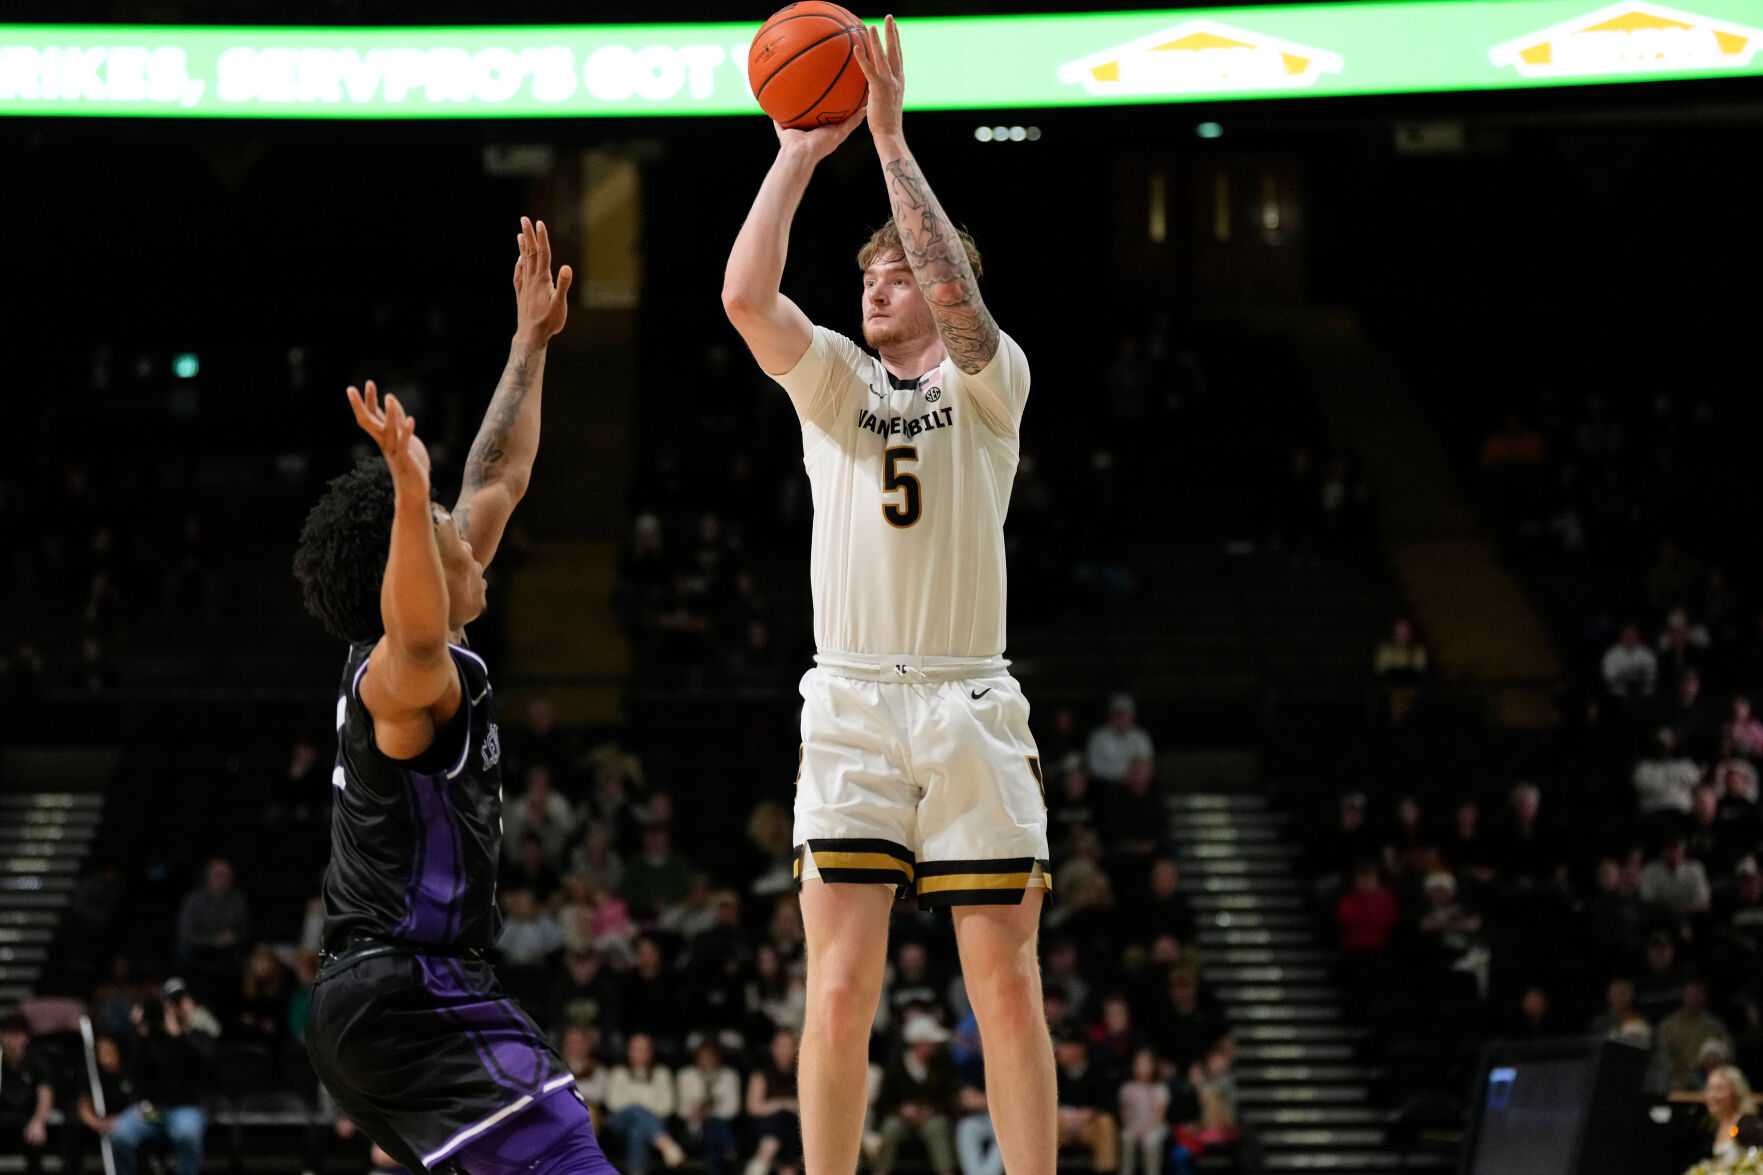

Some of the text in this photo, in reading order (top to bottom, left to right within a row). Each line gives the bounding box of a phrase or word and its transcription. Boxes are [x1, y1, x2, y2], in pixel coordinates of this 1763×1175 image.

[216, 46, 578, 103] SERVPRO'S
[583, 44, 726, 101] GOT
[926, 388, 940, 402] SEC
[858, 407, 953, 439] VANERBILT
[882, 445, 922, 529] 5
